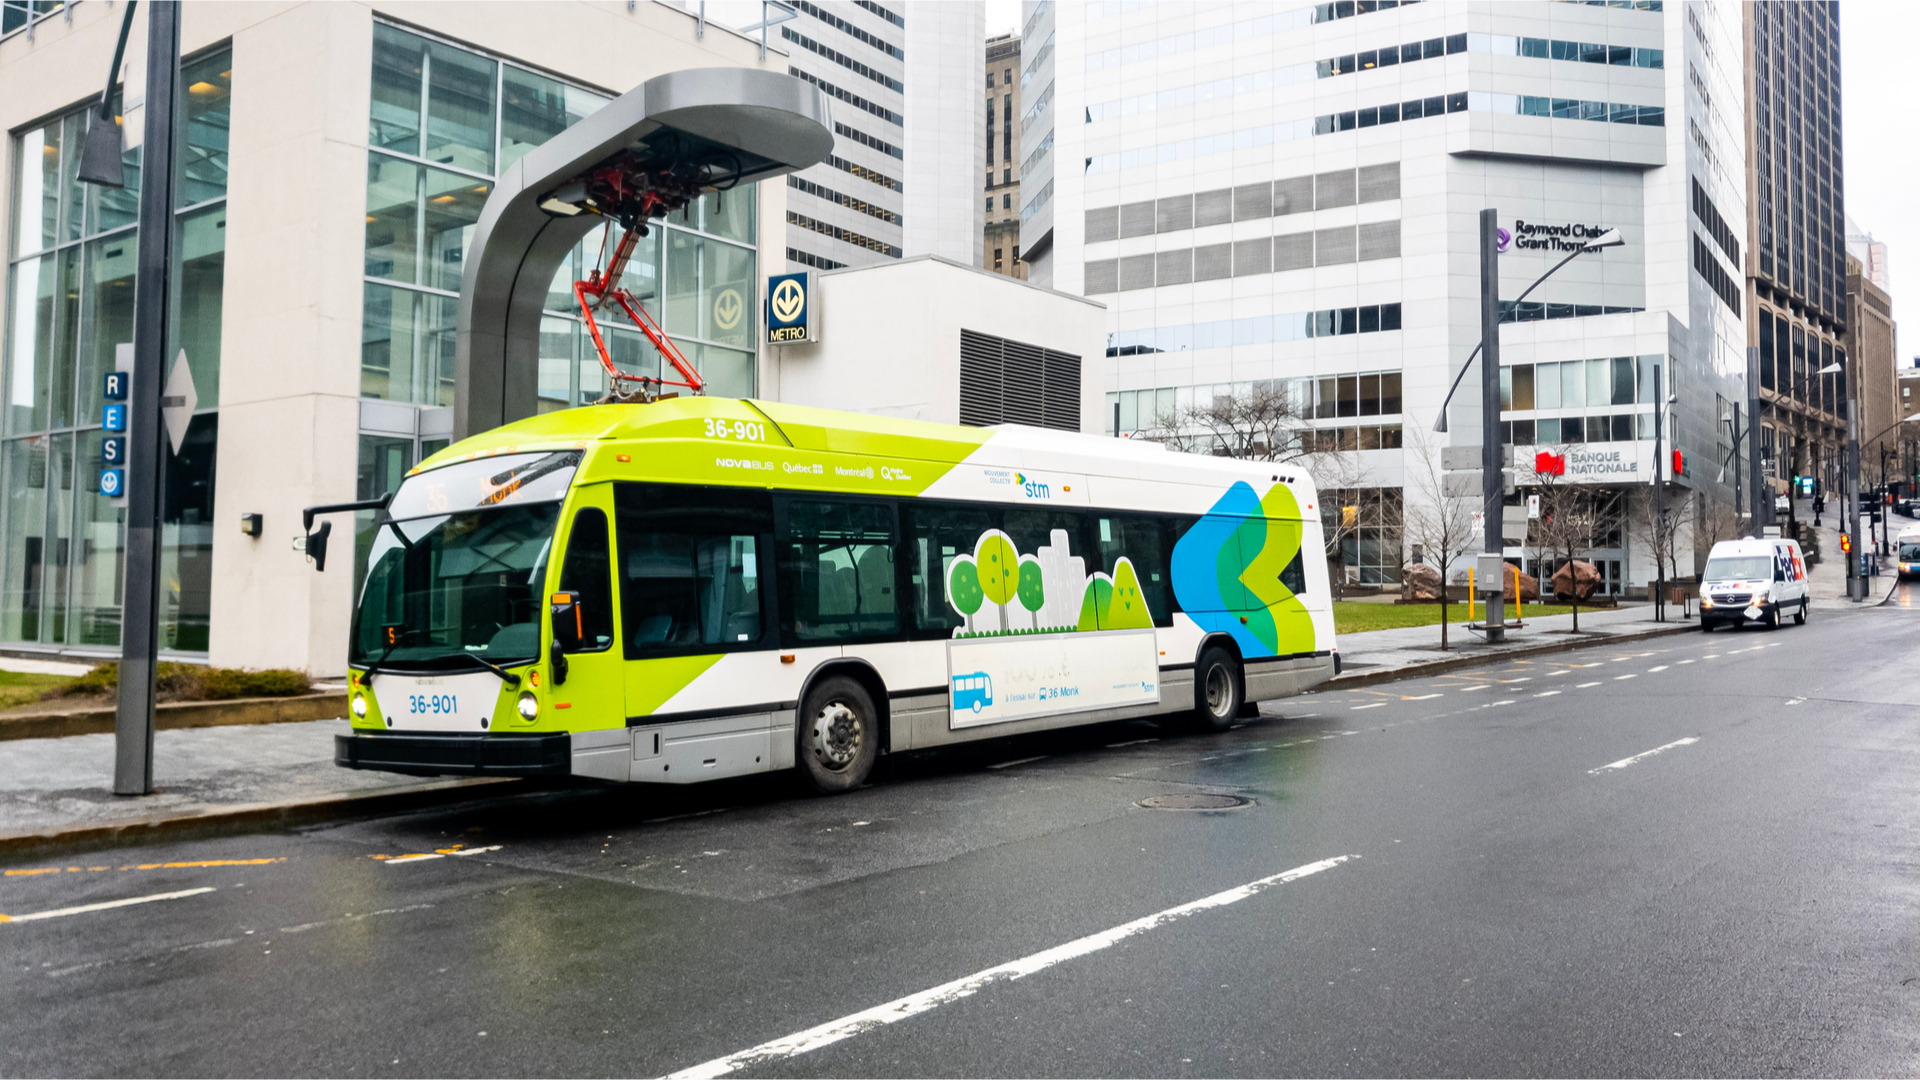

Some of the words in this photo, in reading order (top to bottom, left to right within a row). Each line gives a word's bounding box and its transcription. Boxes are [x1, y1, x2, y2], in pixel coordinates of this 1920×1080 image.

[1515, 219, 1570, 237] Raymond
[1572, 223, 1614, 239] Chab
[1515, 236, 1549, 250] Grant
[704, 418, 765, 442] 36-901
[1571, 451, 1620, 463] BANQUE
[782, 461, 812, 474] Québec
[835, 466, 866, 478] Montréal
[984, 469, 1010, 477] MOUVEMENT
[1571, 462, 1638, 475] NATIONALE
[424, 482, 448, 512] 36
[480, 471, 523, 504] Monk
[1025, 480, 1050, 499] stm
[1774, 545, 1805, 582] FedEx
[1709, 583, 1754, 592] FedEx
[1048, 687, 1059, 699] 36
[1060, 685, 1080, 698] Monk
[409, 694, 457, 714] 36-901
